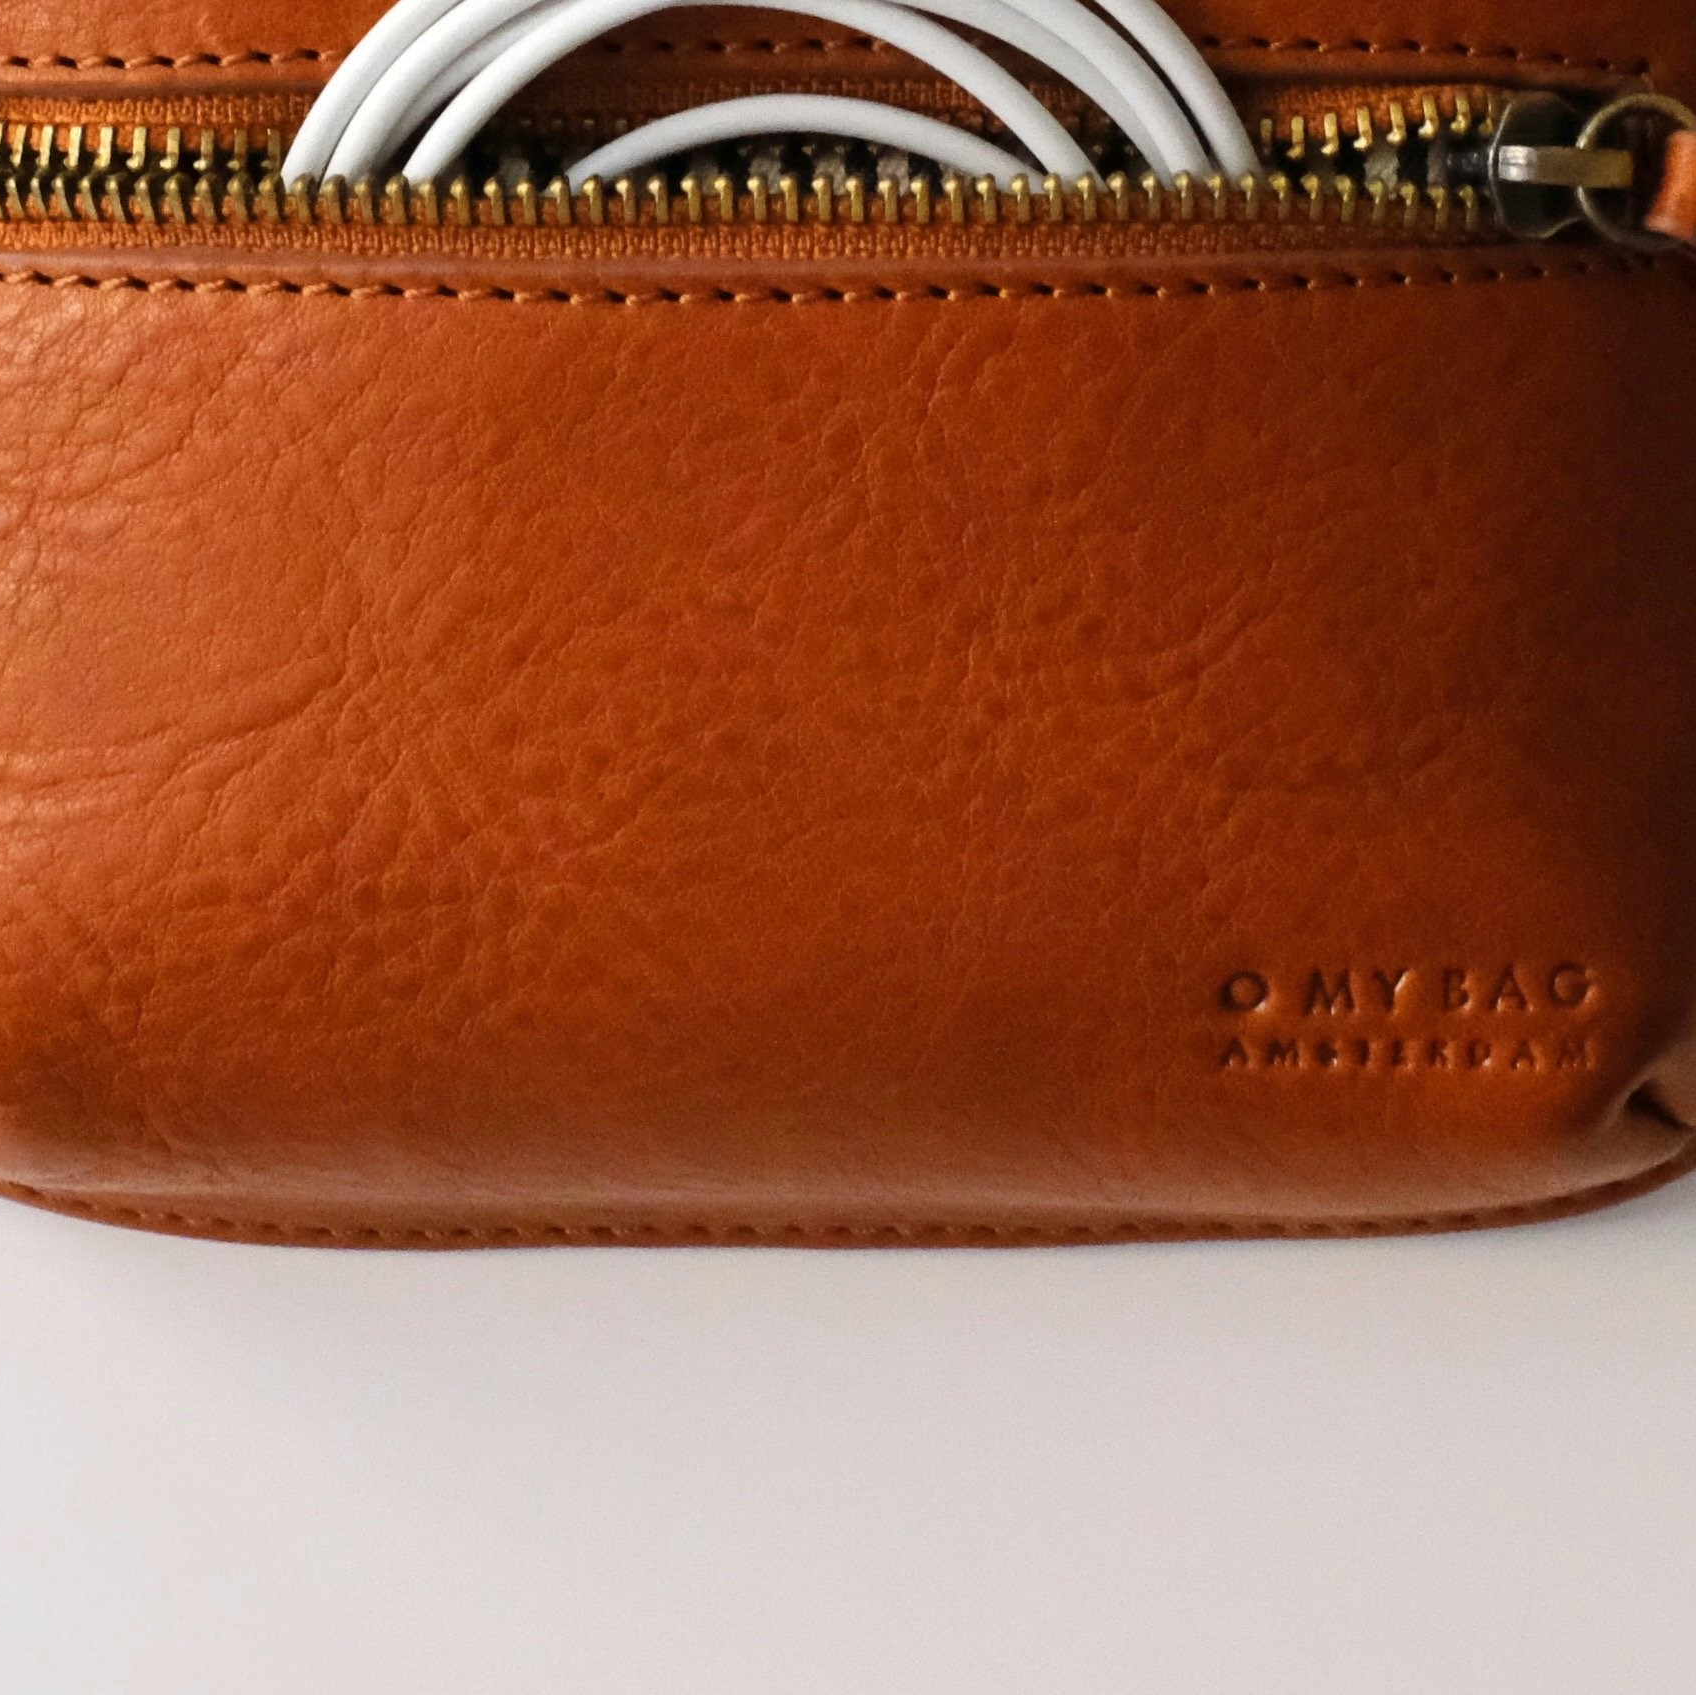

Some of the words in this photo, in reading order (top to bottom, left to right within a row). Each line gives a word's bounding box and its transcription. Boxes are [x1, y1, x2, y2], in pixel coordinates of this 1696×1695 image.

[1219, 970, 1270, 1013] O
[1307, 968, 1411, 1016] MY
[1444, 962, 1599, 1014] BAG
[1219, 1036, 1598, 1071] AMSTERDAM
